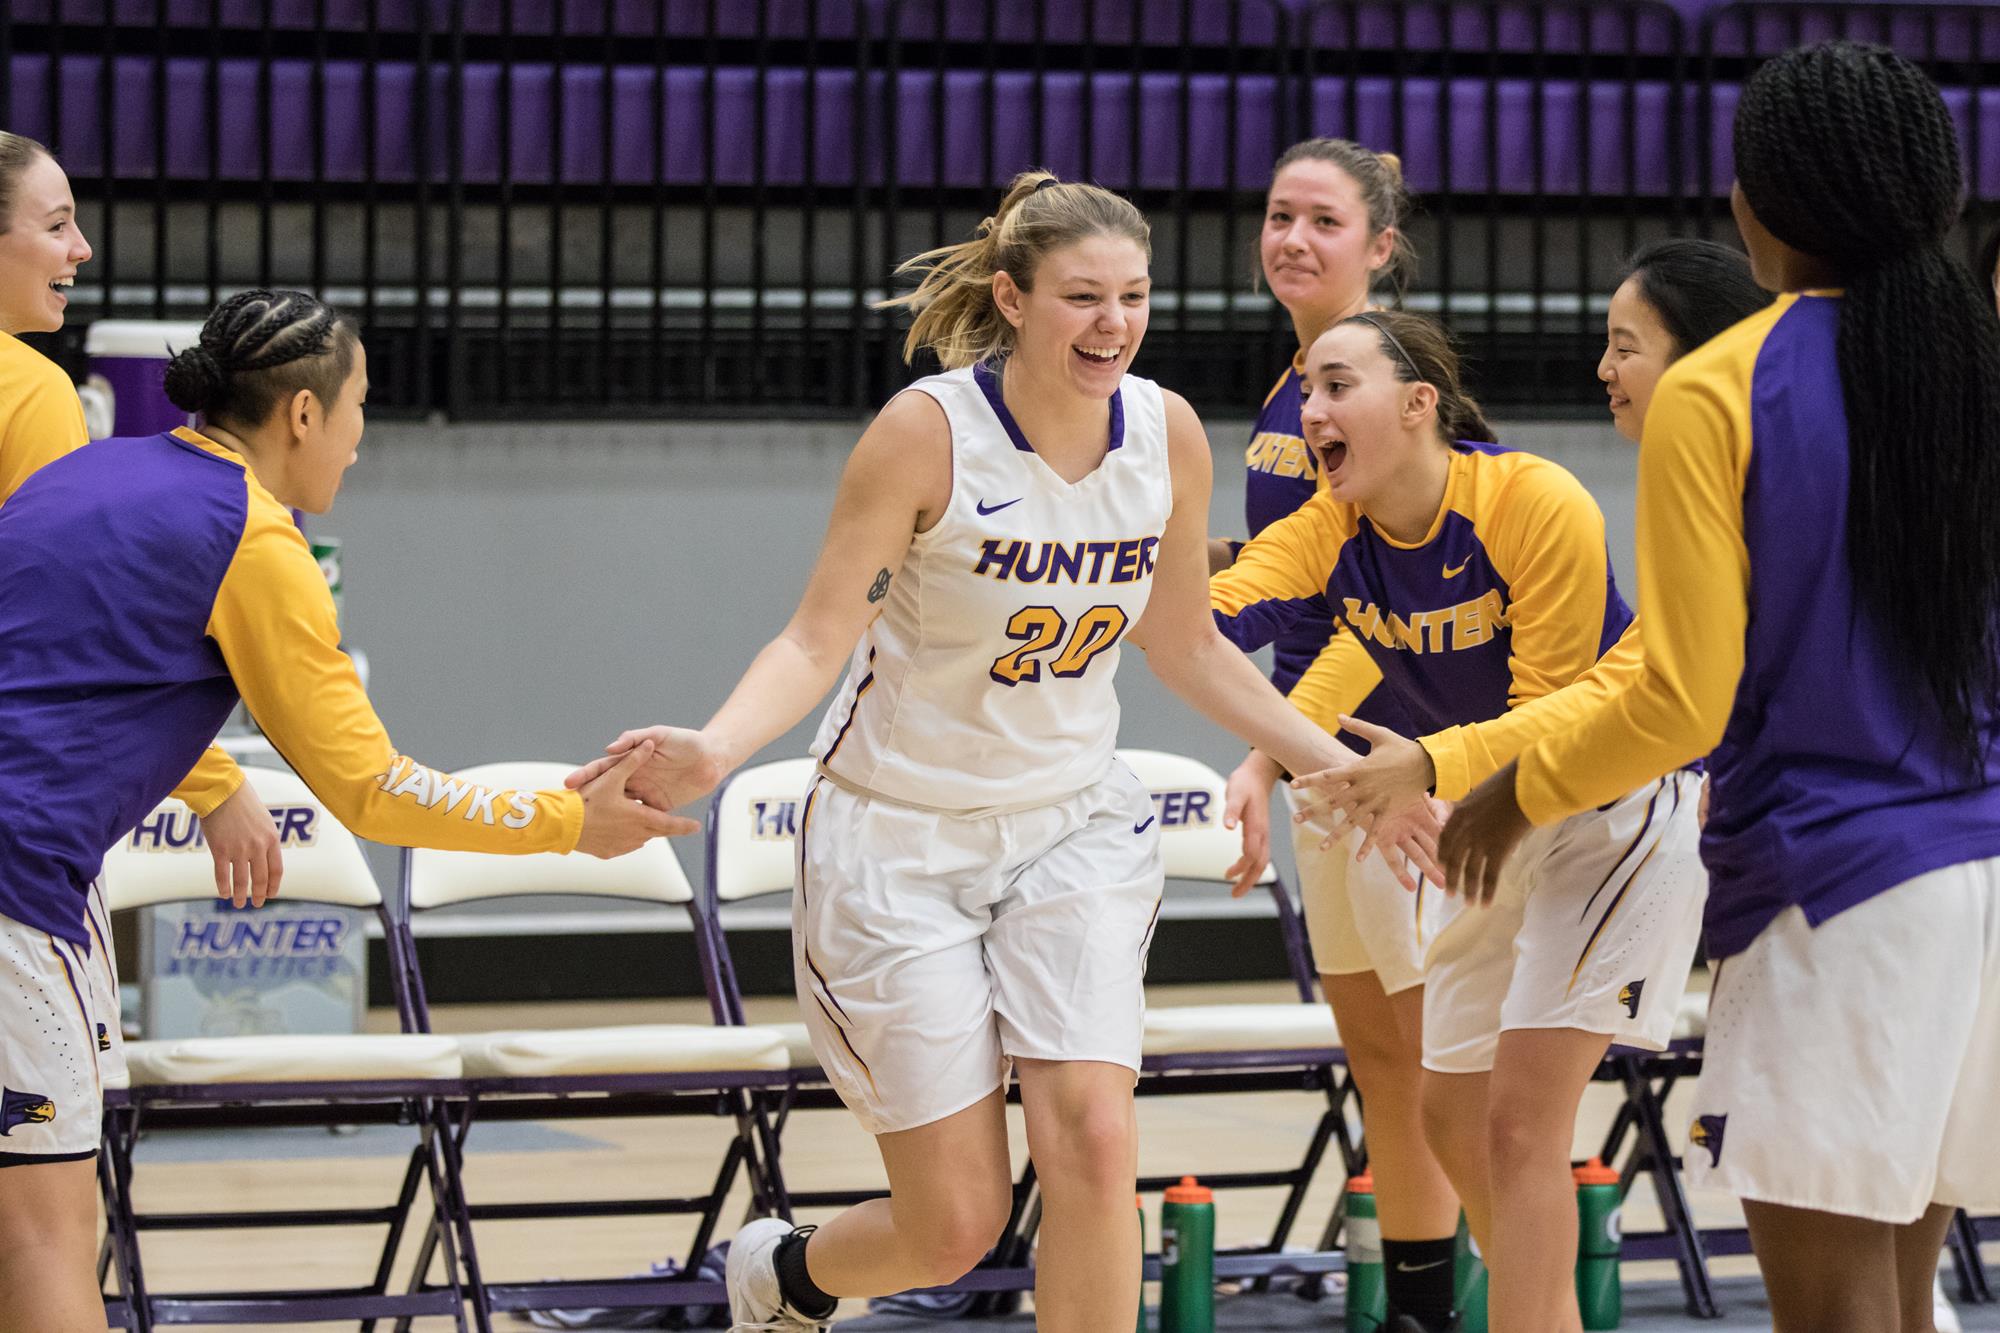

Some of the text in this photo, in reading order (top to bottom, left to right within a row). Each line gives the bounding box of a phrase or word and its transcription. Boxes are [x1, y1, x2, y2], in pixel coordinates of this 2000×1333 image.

[1246, 432, 1317, 480] UNTER
[973, 536, 1160, 585] HUNTER
[989, 604, 1130, 687] 20
[1343, 588, 1511, 654] HUNTER
[178, 917, 344, 953] HUNTER
